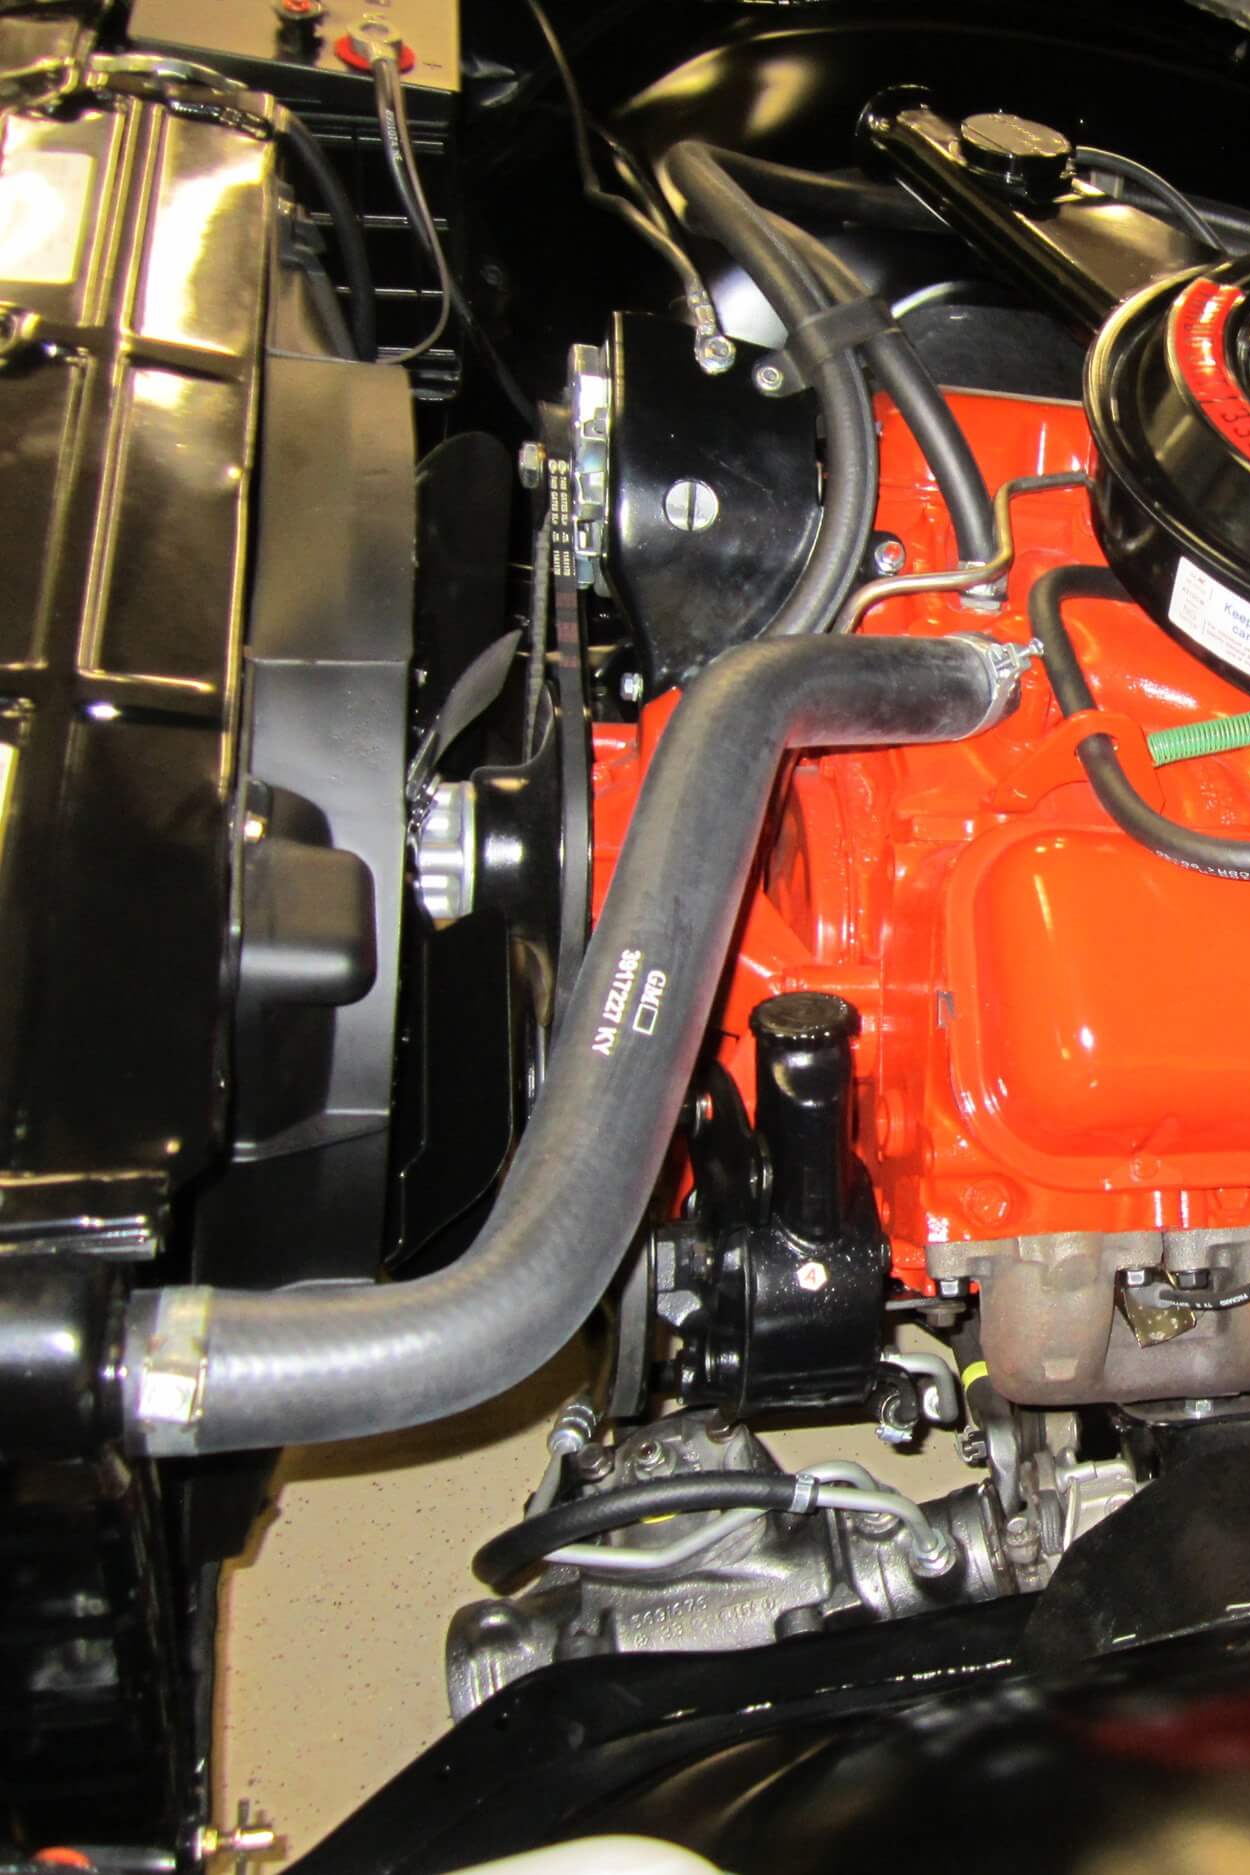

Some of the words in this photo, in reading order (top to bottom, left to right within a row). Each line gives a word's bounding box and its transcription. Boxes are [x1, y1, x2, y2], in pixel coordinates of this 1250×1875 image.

[602, 949, 642, 1023] 3917227
[640, 969, 667, 1008] GM
[591, 1026, 618, 1056] KY
[1219, 1293, 1249, 1307] PACKARD
